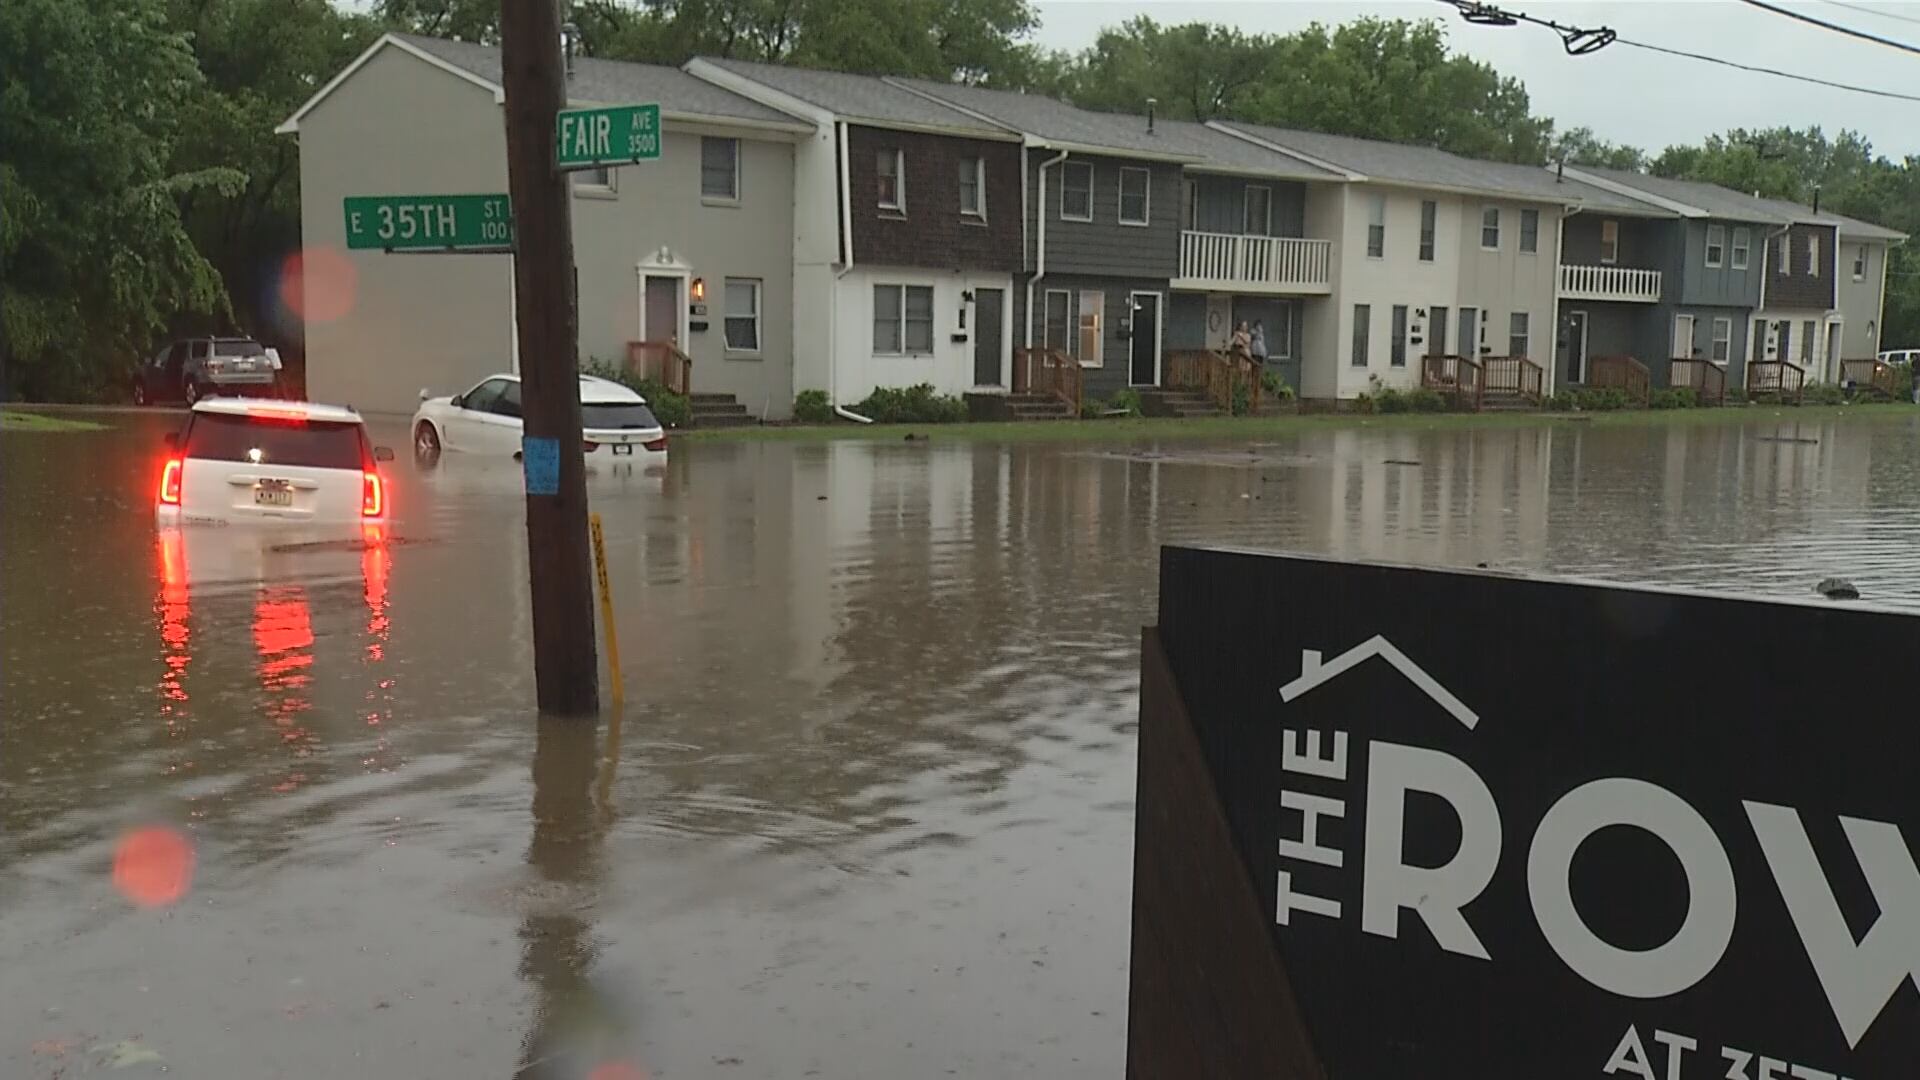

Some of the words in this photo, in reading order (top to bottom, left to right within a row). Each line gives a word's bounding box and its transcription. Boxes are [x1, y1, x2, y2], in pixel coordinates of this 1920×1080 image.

[561, 115, 611, 156] FAIR
[632, 111, 651, 131] AVE
[628, 134, 656, 152] 3500
[351, 213, 363, 234] E
[377, 205, 456, 239] 35TH
[484, 201, 501, 218] ST
[482, 222, 507, 240] 100
[1276, 729, 1348, 926] THE
[1361, 740, 1920, 1050] ROW
[1602, 1023, 1698, 1080] AT
